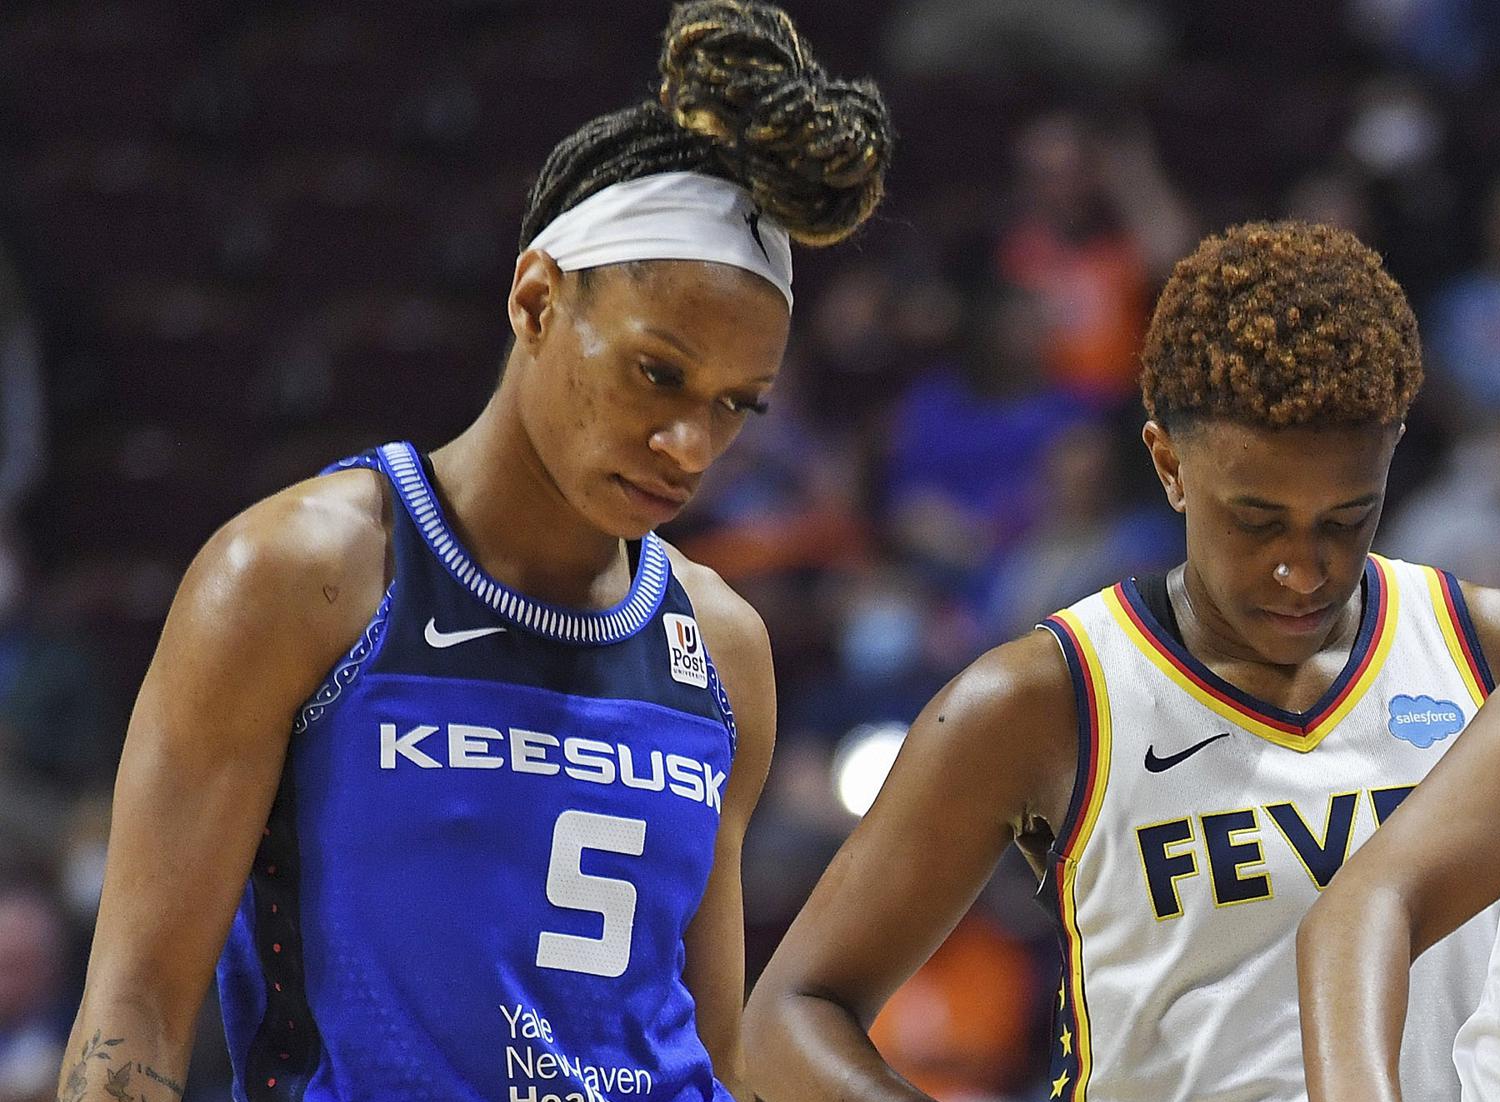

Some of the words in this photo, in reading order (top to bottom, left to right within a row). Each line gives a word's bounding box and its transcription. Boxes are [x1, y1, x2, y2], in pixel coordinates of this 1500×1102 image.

[672, 647, 705, 674] Post
[1396, 710, 1457, 726] salesforce
[380, 723, 726, 814] KEESUSK
[1135, 783, 1421, 922] FEV
[536, 809, 647, 978] 5
[500, 1004, 554, 1043] Yale
